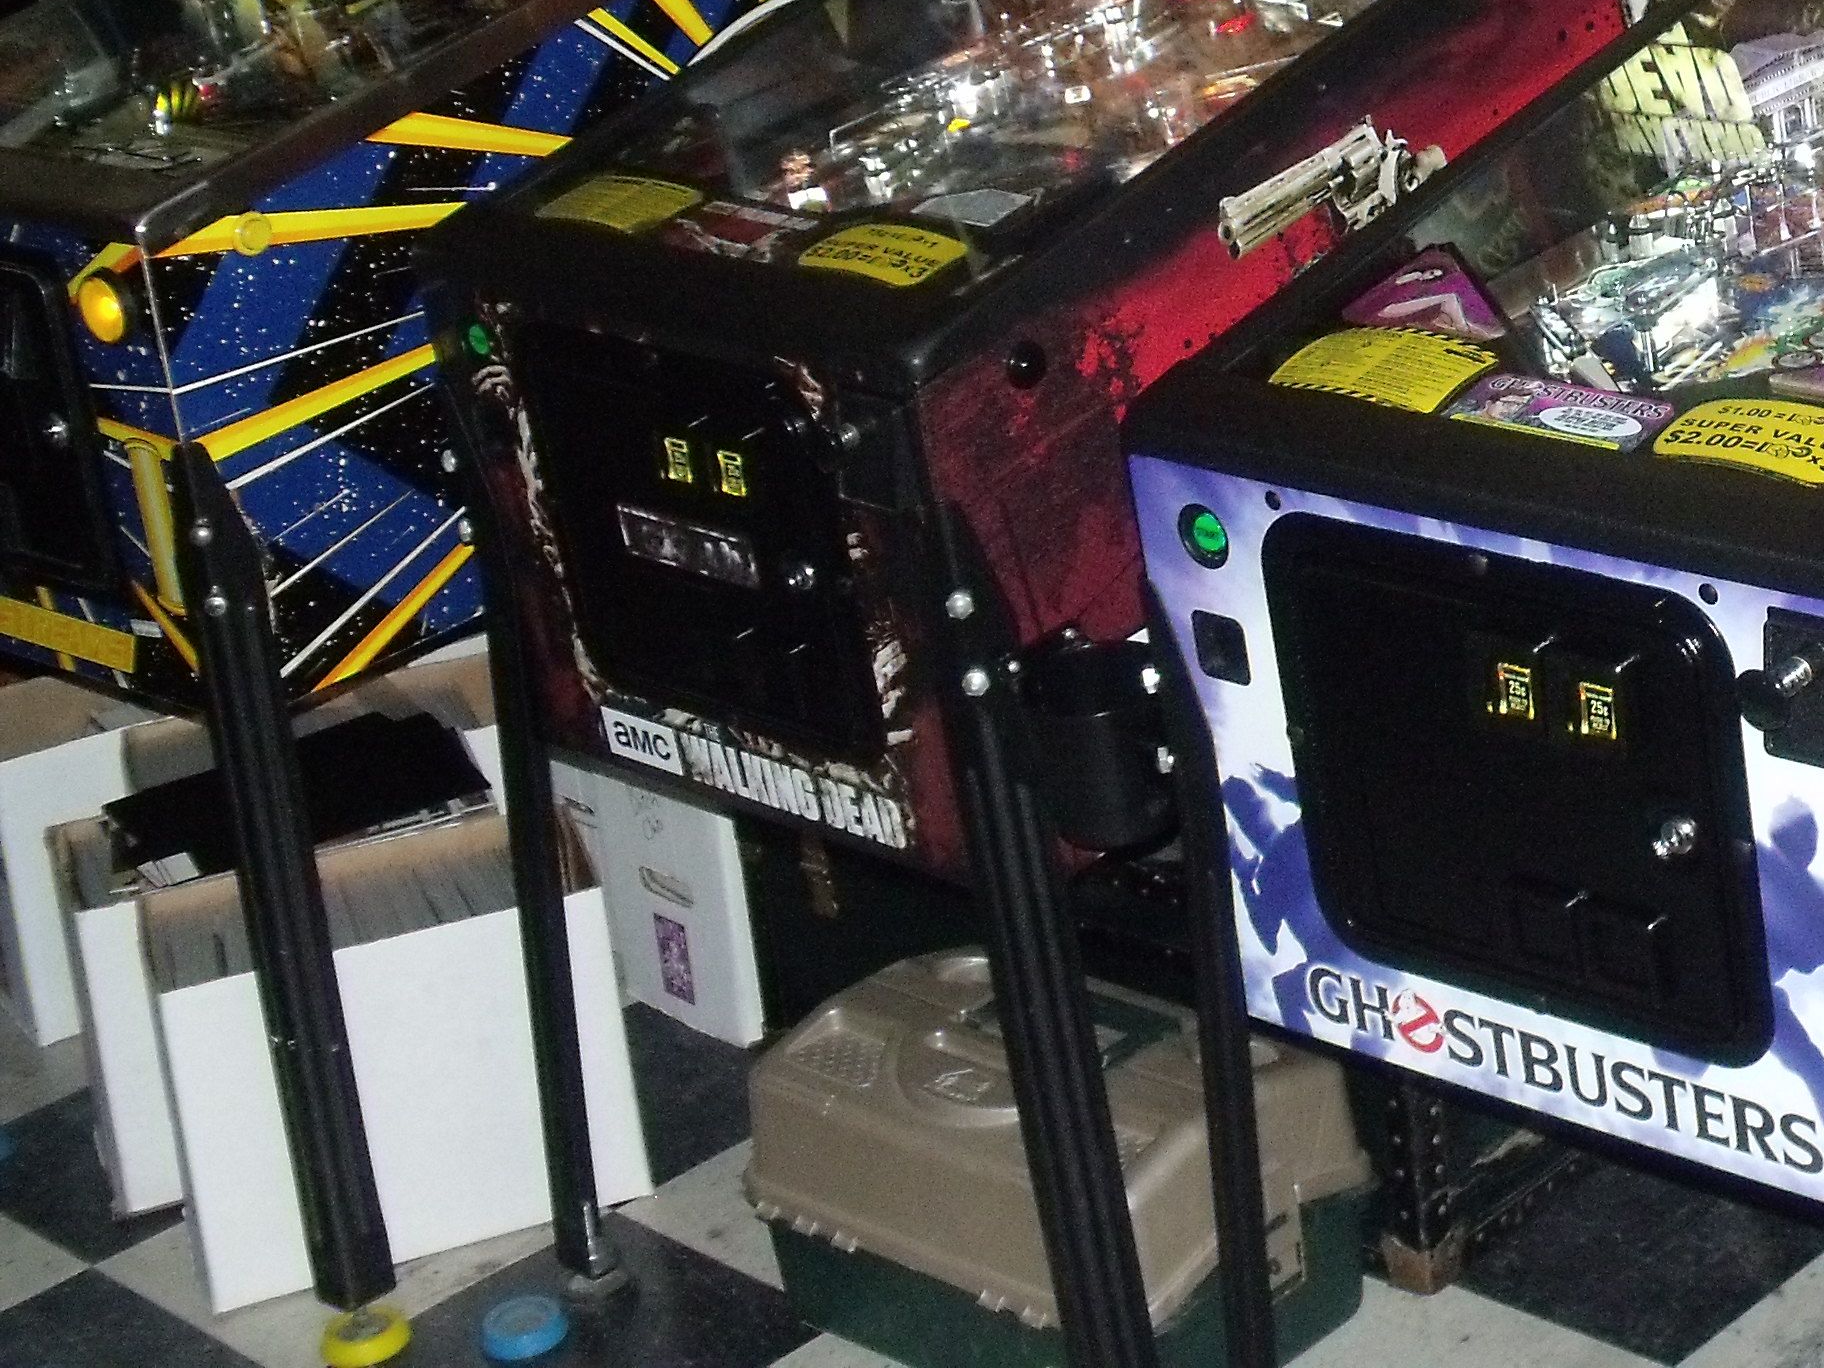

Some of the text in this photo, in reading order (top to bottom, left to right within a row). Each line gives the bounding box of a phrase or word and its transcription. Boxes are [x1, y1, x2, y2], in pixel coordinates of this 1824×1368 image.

[1488, 374, 1661, 421] GHOSTBUSTERS
[1680, 418, 1763, 435] SUPER
[680, 730, 821, 823] WALKING
[817, 776, 907, 850] DEAD
